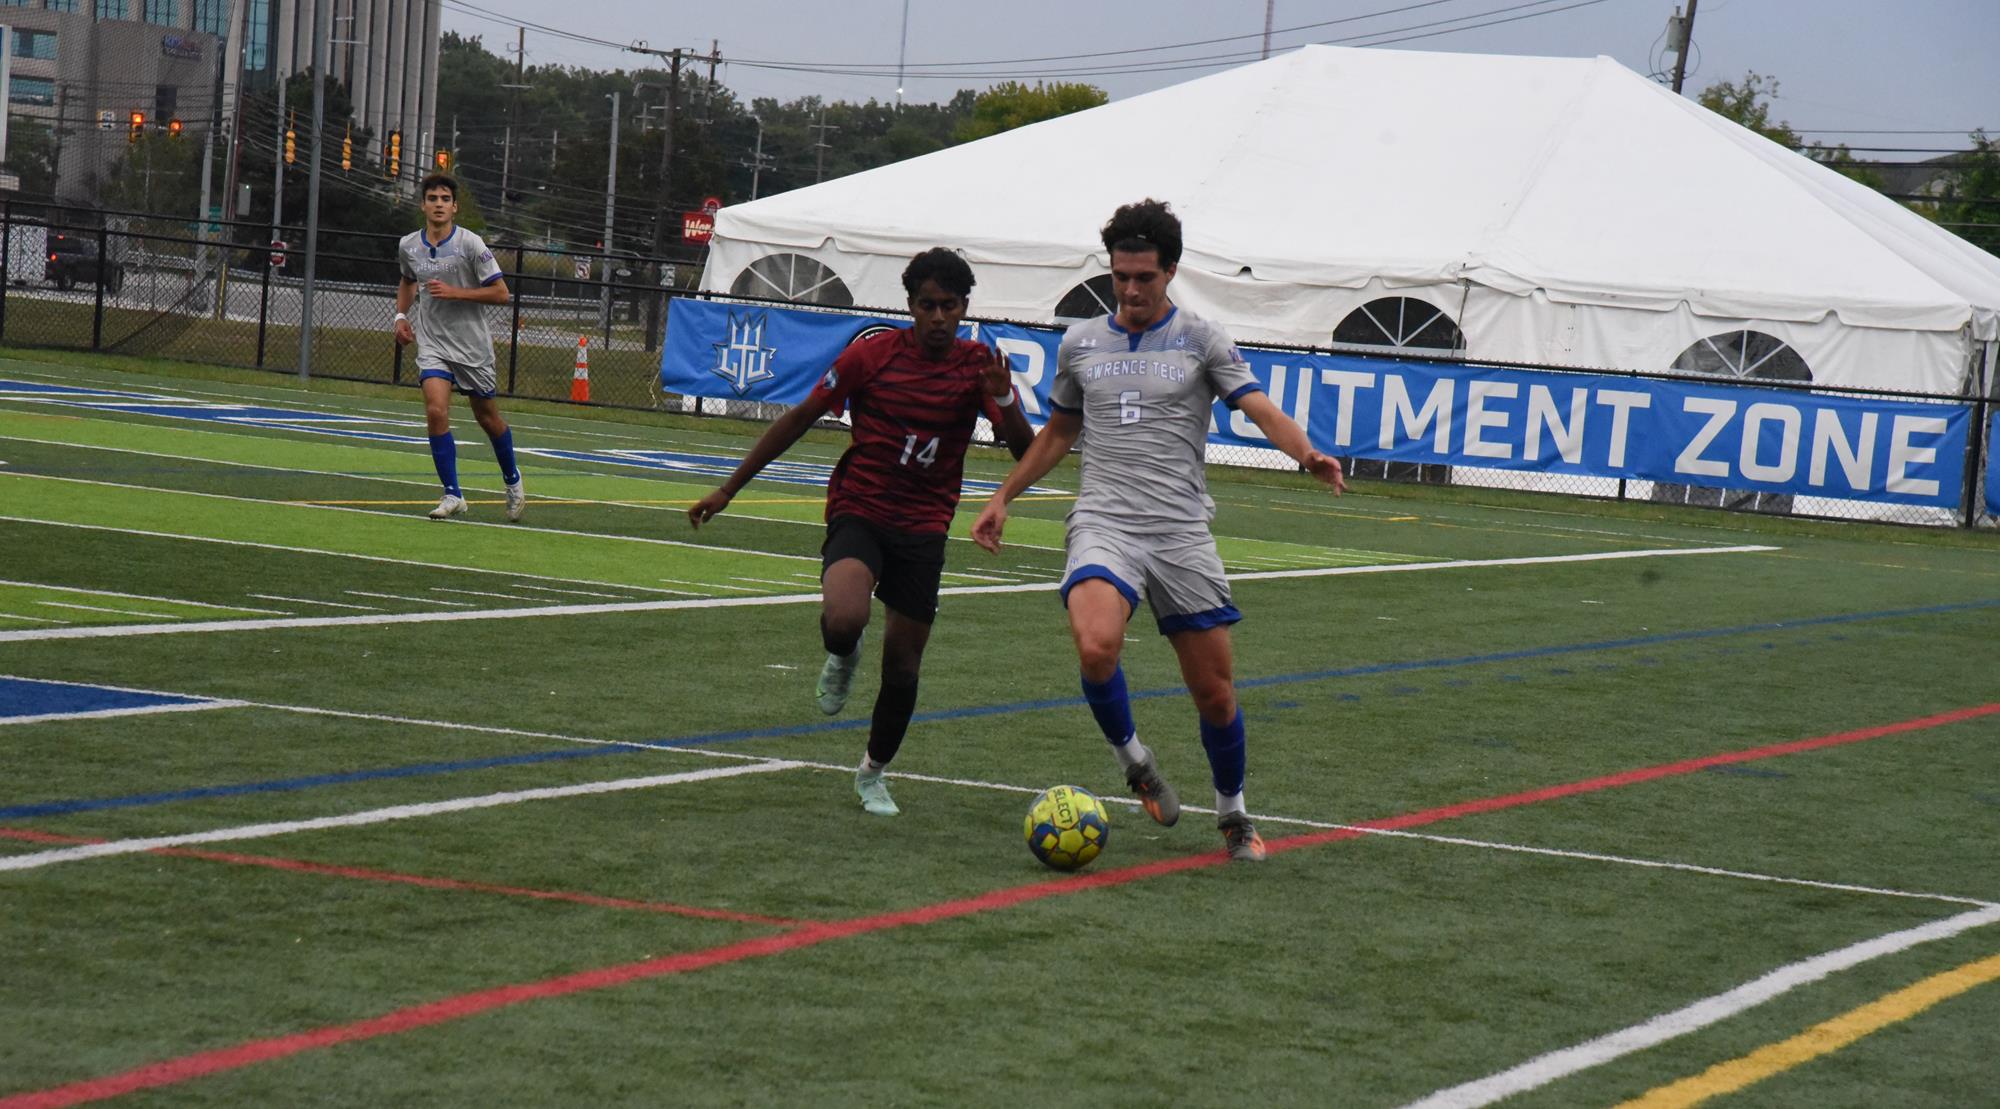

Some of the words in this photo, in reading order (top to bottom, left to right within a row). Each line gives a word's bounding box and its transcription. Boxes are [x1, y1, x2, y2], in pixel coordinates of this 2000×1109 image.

[1086, 360, 1147, 383] AWRENCE
[1153, 361, 1185, 384] TECH
[995, 336, 1651, 468] RUITMENT
[1674, 396, 1948, 496] ZONE
[1119, 390, 1142, 425] 6
[900, 434, 940, 469] 14
